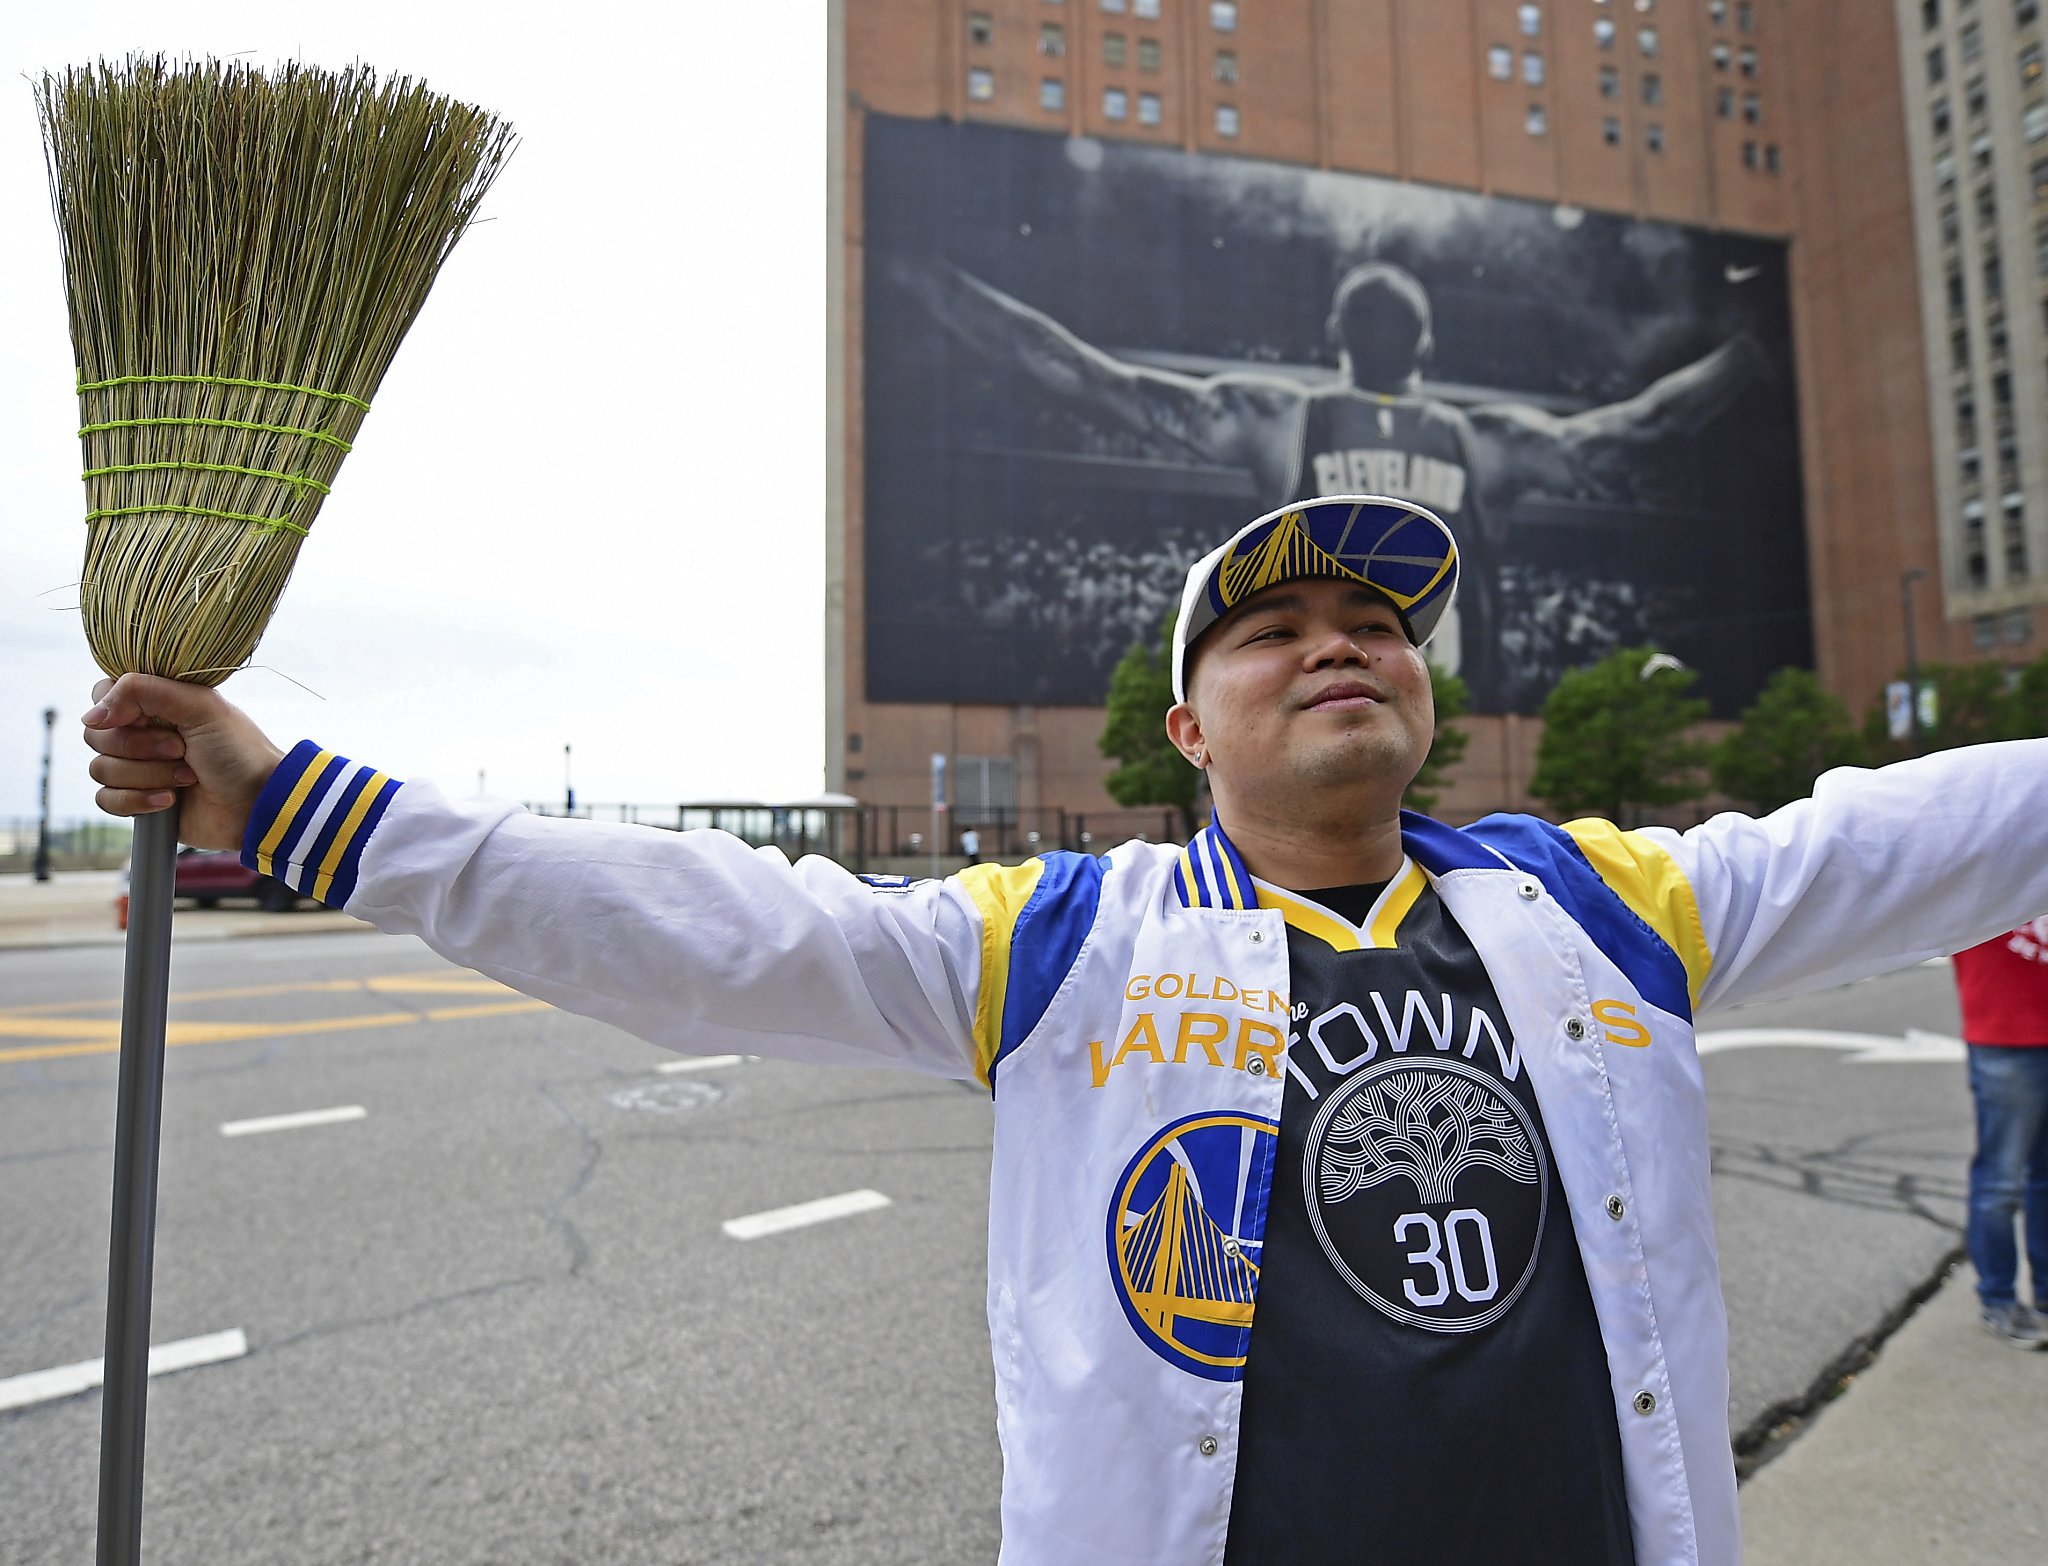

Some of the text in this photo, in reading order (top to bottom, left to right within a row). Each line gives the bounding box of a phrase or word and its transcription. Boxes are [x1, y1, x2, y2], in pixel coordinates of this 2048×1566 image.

[1125, 973, 1290, 1016] GOLDEN
[1287, 989, 1521, 1100] TOWN
[1393, 1208, 1499, 1307] 30
